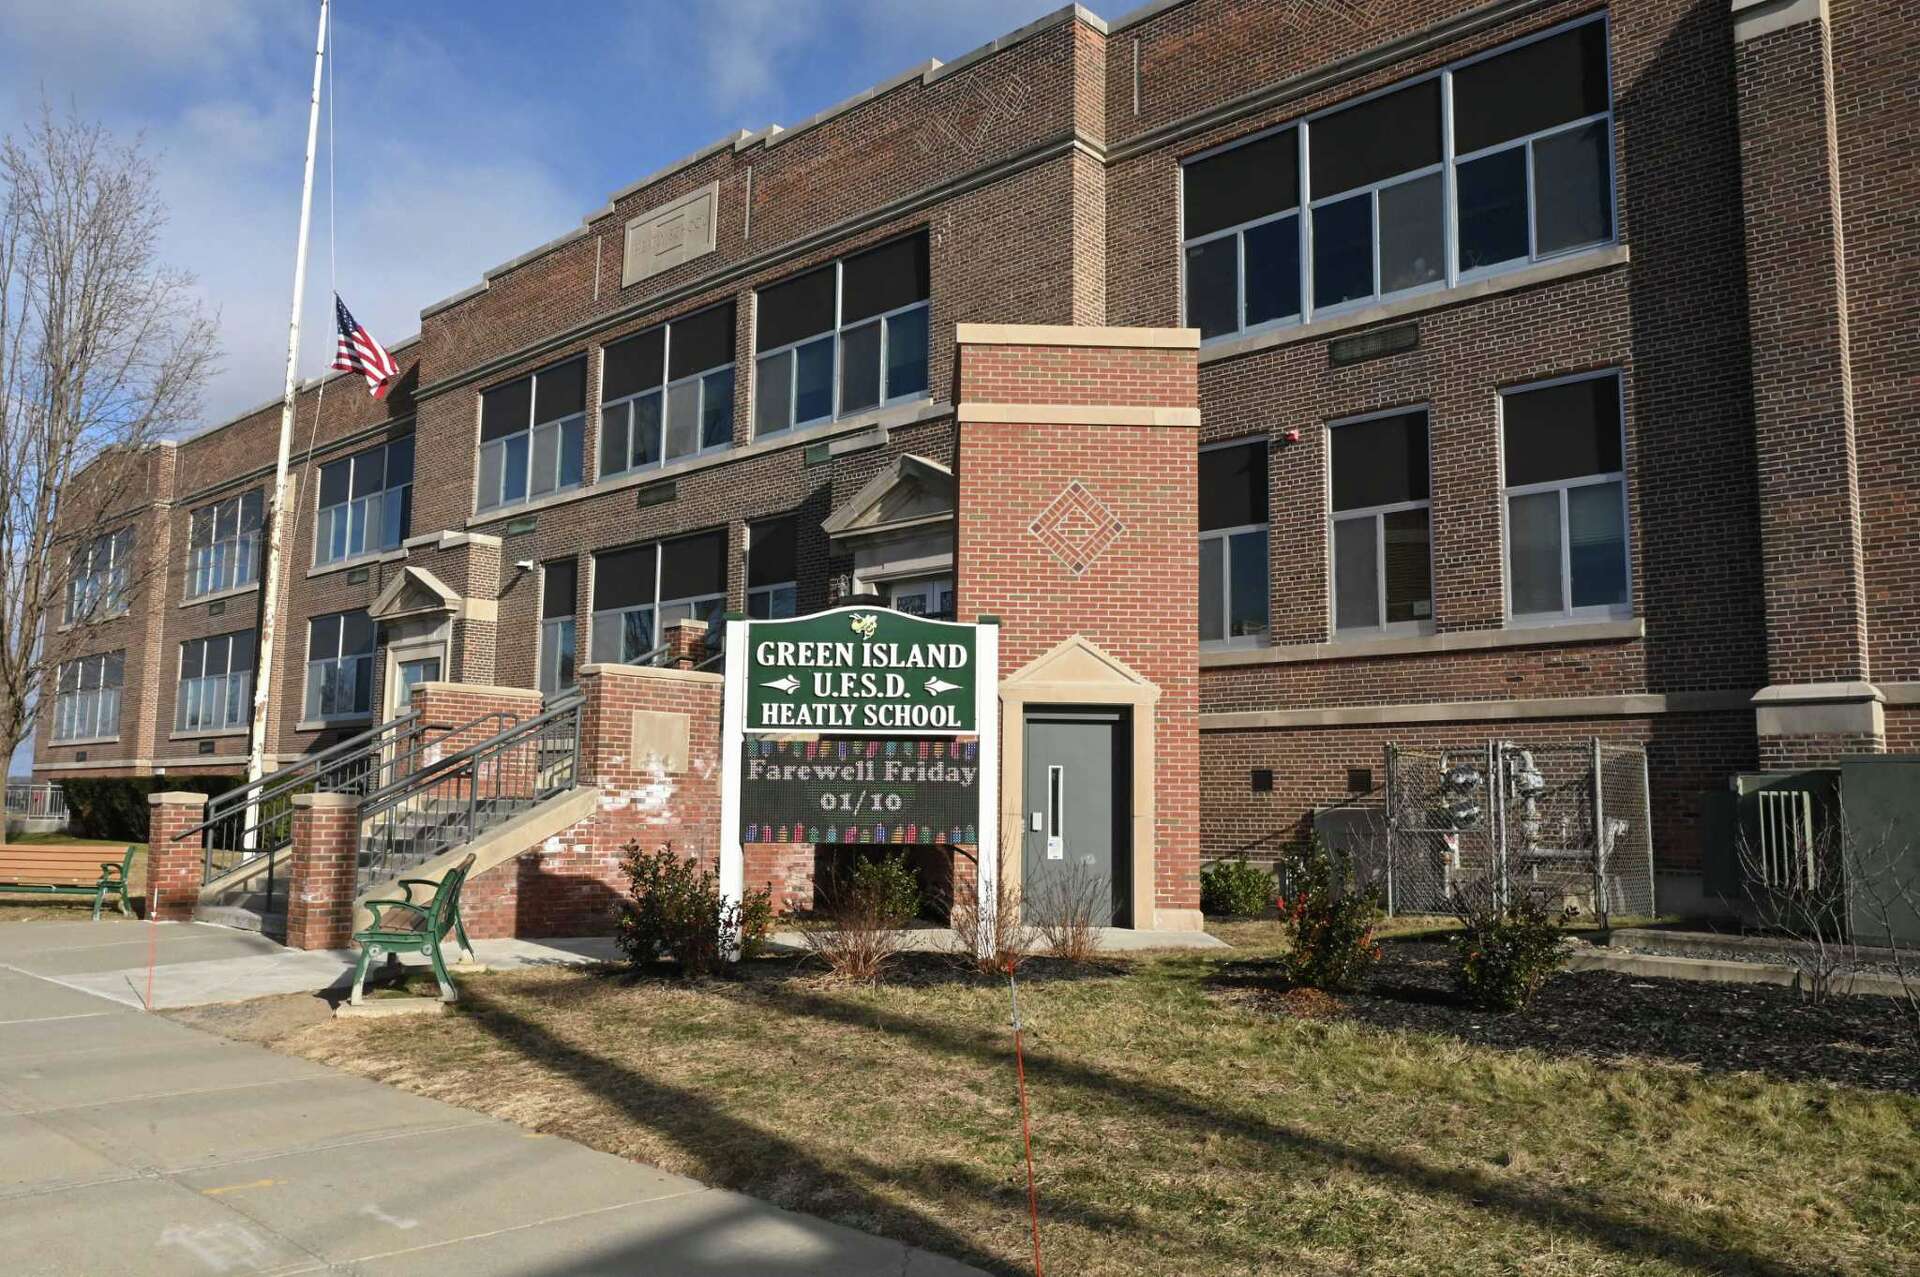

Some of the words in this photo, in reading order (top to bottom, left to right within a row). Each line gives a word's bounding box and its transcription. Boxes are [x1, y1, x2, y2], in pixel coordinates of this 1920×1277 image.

[756, 641, 854, 668] GREEN
[862, 642, 968, 669] ISLAND
[813, 672, 911, 699] U.F.S.D.
[761, 703, 858, 726] HEATLY
[864, 704, 961, 727] SCHOOL
[747, 759, 875, 781] Farewell
[883, 760, 977, 787] Friday
[820, 790, 902, 816] 01/10
